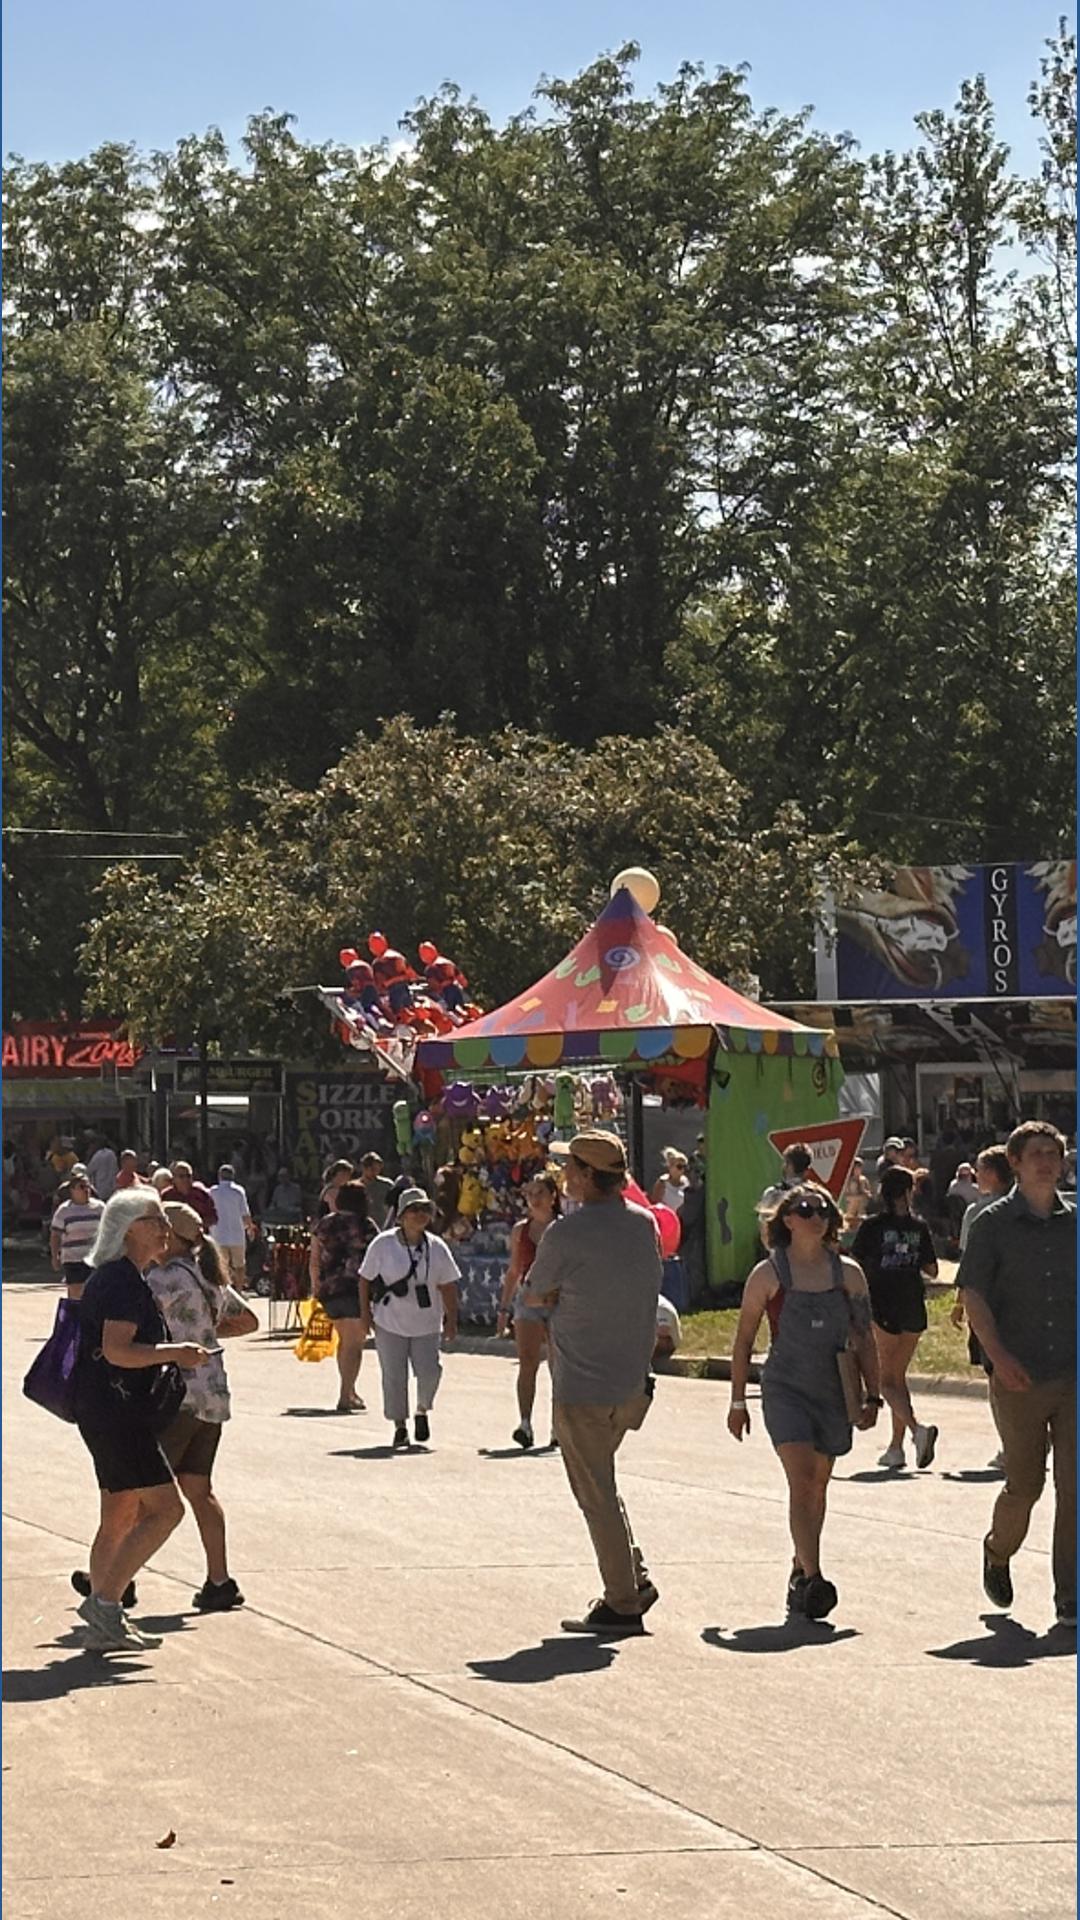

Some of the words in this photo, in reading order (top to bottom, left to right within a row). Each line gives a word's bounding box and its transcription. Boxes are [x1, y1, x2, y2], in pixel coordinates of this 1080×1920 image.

[991, 868, 1011, 992] GYROS
[2, 1035, 67, 1067] AIRY
[296, 1081, 395, 1105] SIZZLE
[298, 1106, 384, 1130] PORK
[808, 1146, 836, 1158] IELD
